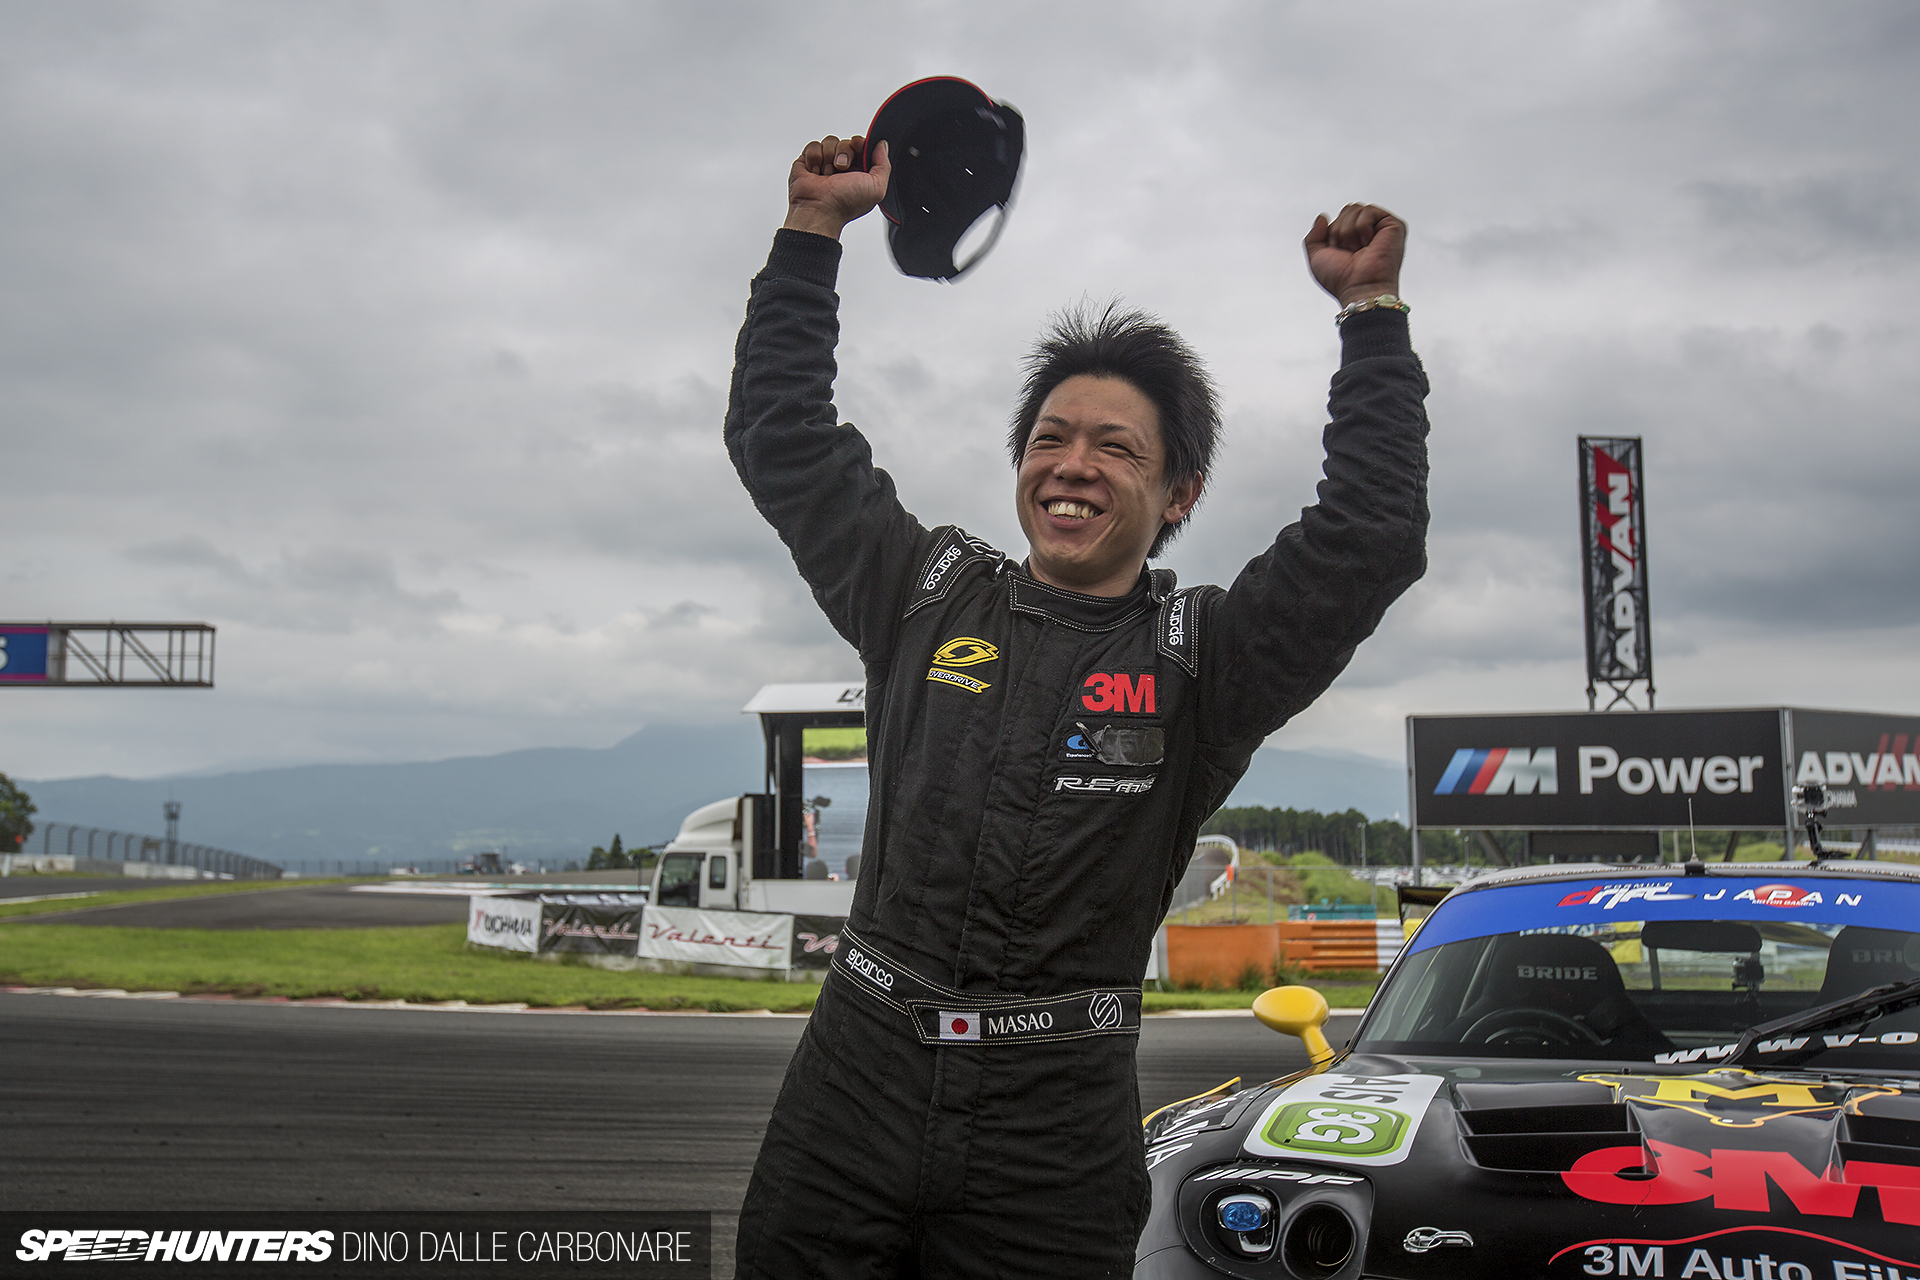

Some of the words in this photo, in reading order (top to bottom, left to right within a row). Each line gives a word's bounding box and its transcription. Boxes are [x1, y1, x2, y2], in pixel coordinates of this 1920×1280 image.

[923, 543, 962, 590] sparco
[1607, 472, 1638, 674] ADVAN
[1169, 595, 1187, 646] sparco
[1081, 672, 1156, 713] 3M
[1484, 746, 1559, 795] M
[1578, 745, 1764, 794] Power
[1703, 888, 1863, 907] JAPAN
[543, 917, 640, 940] Valenti
[646, 922, 785, 950] Valenti
[845, 947, 894, 993] sparco
[1517, 964, 1598, 981] BRIDE
[987, 1011, 1054, 1036] MASAO
[1319, 1074, 1411, 1105] AIS
[1297, 1106, 1381, 1145] 3G
[1561, 1138, 1920, 1227] 3M
[1582, 1245, 1664, 1278] 3M
[1681, 1248, 1812, 1280] Auto
